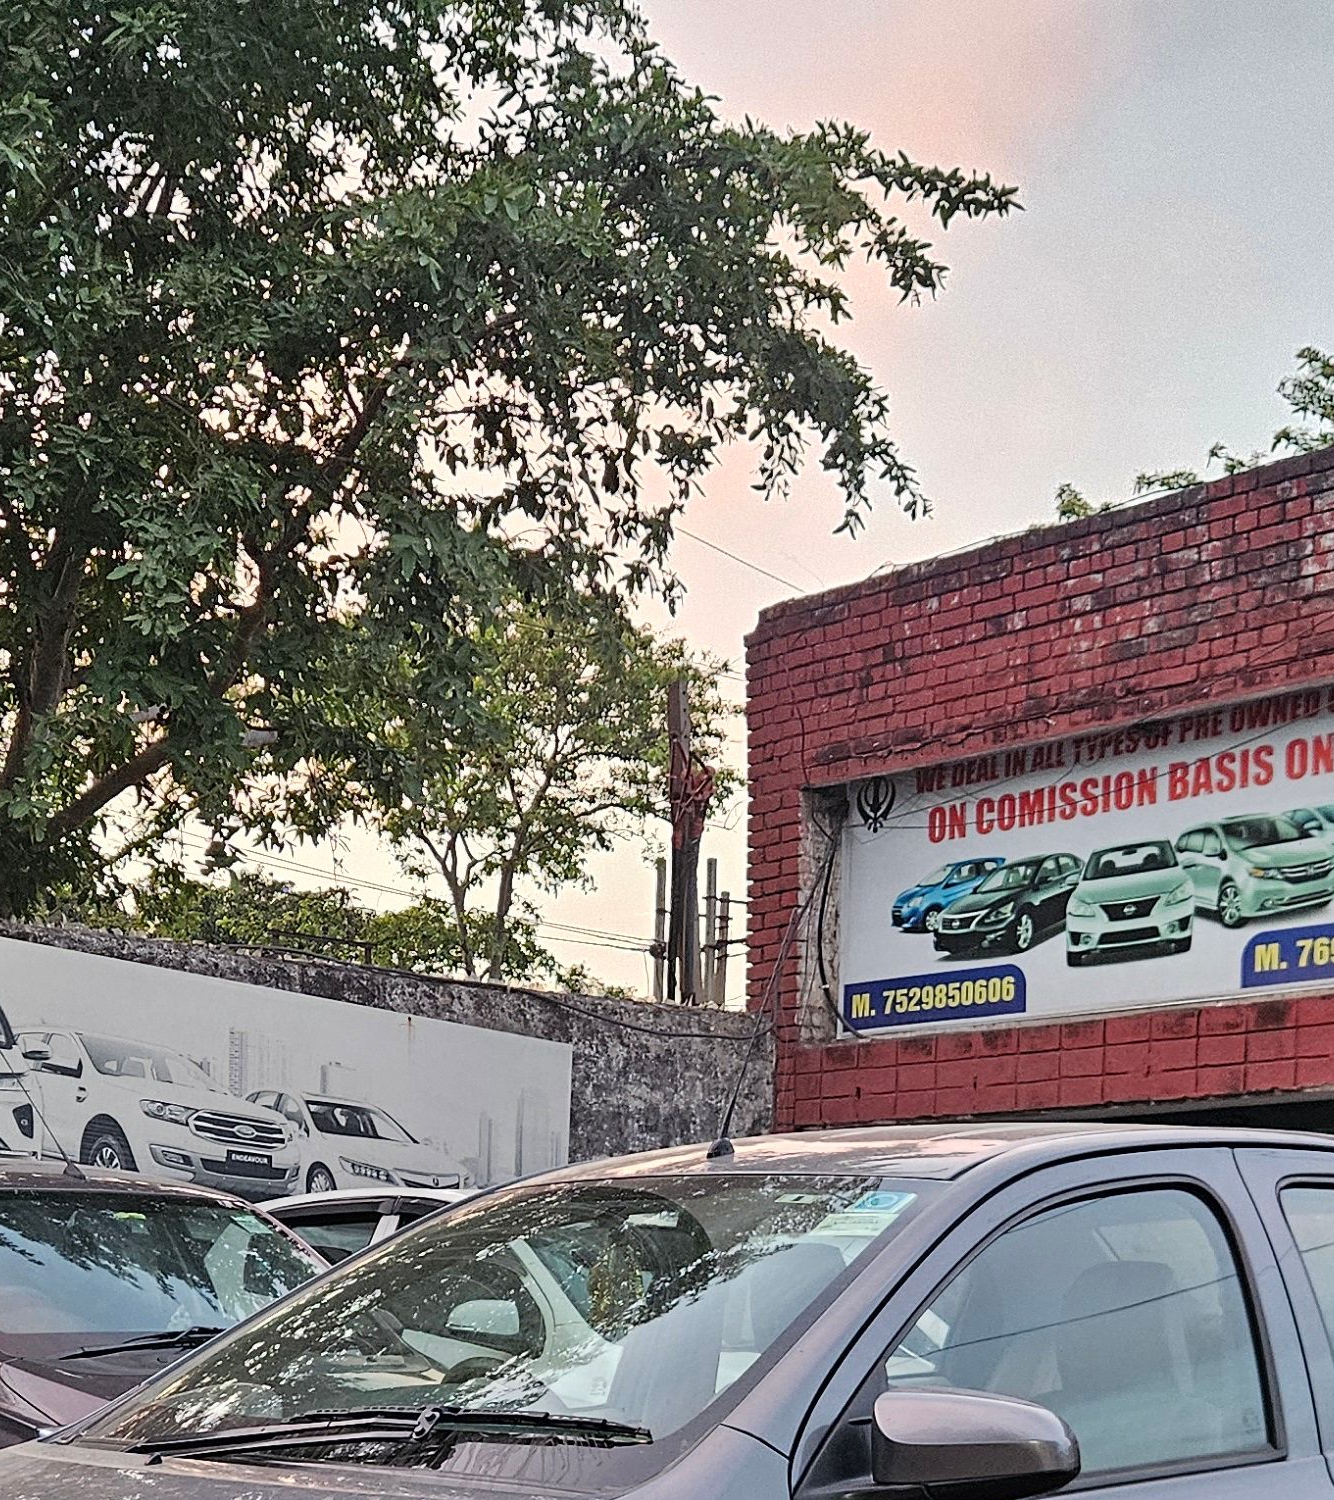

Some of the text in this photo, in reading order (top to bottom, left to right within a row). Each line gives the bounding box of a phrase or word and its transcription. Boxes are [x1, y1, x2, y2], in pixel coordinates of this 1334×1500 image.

[917, 767, 947, 795] WE
[951, 754, 1000, 787] DEAL
[1004, 748, 1026, 778] IN
[1030, 741, 1066, 772] ALL
[1069, 728, 1139, 764] TYPES
[1178, 712, 1222, 743] PRE
[1229, 688, 1322, 734] OWNED
[928, 802, 966, 843] ON
[975, 766, 1158, 835] COMISSION
[1168, 743, 1274, 802] BASIS
[1253, 942, 1288, 973] M.
[851, 975, 1016, 1018] M. 7529850606
[231, 1153, 269, 1164] ENDEAVOUR
